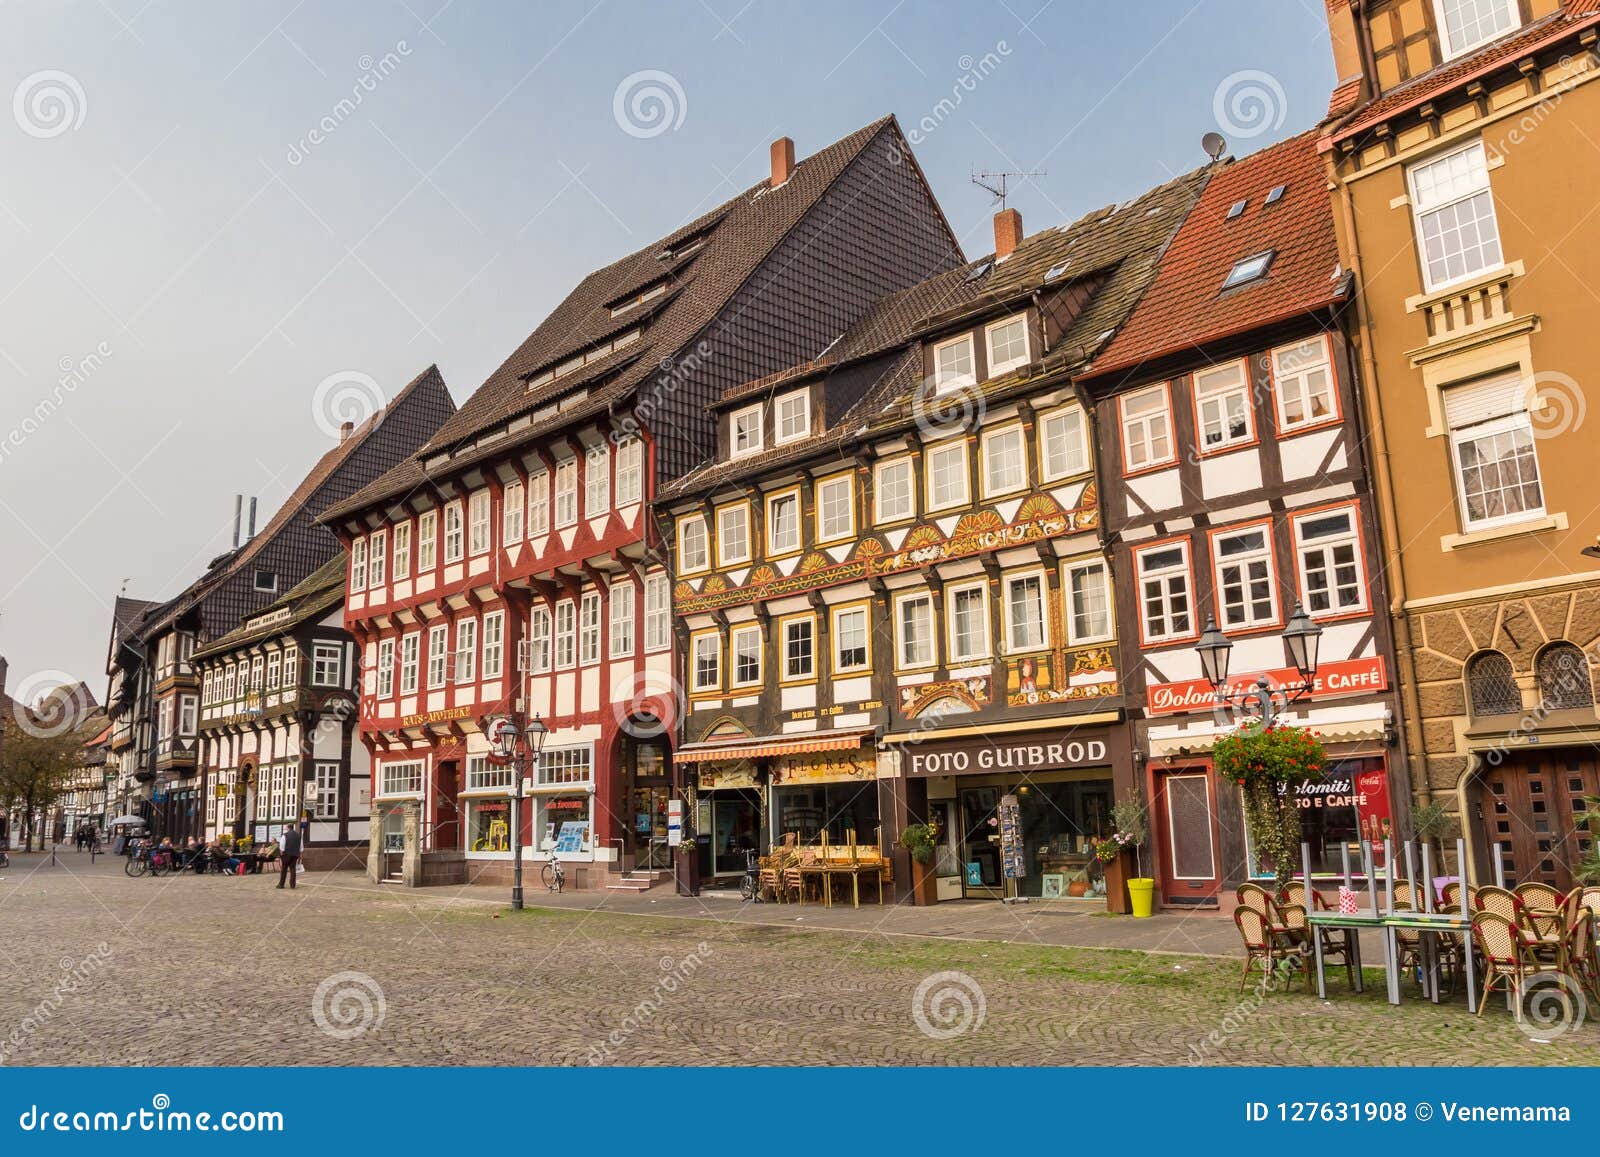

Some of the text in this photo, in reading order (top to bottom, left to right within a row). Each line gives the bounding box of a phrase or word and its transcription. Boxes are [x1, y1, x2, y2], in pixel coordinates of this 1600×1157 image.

[1153, 683, 1242, 709] Dolomiti
[1248, 679, 1308, 695] GLATO
[1327, 667, 1380, 689] CAFFÉ
[912, 740, 1106, 773] FOTO GUTBROD
[1326, 792, 1367, 807] CAFFÉ
